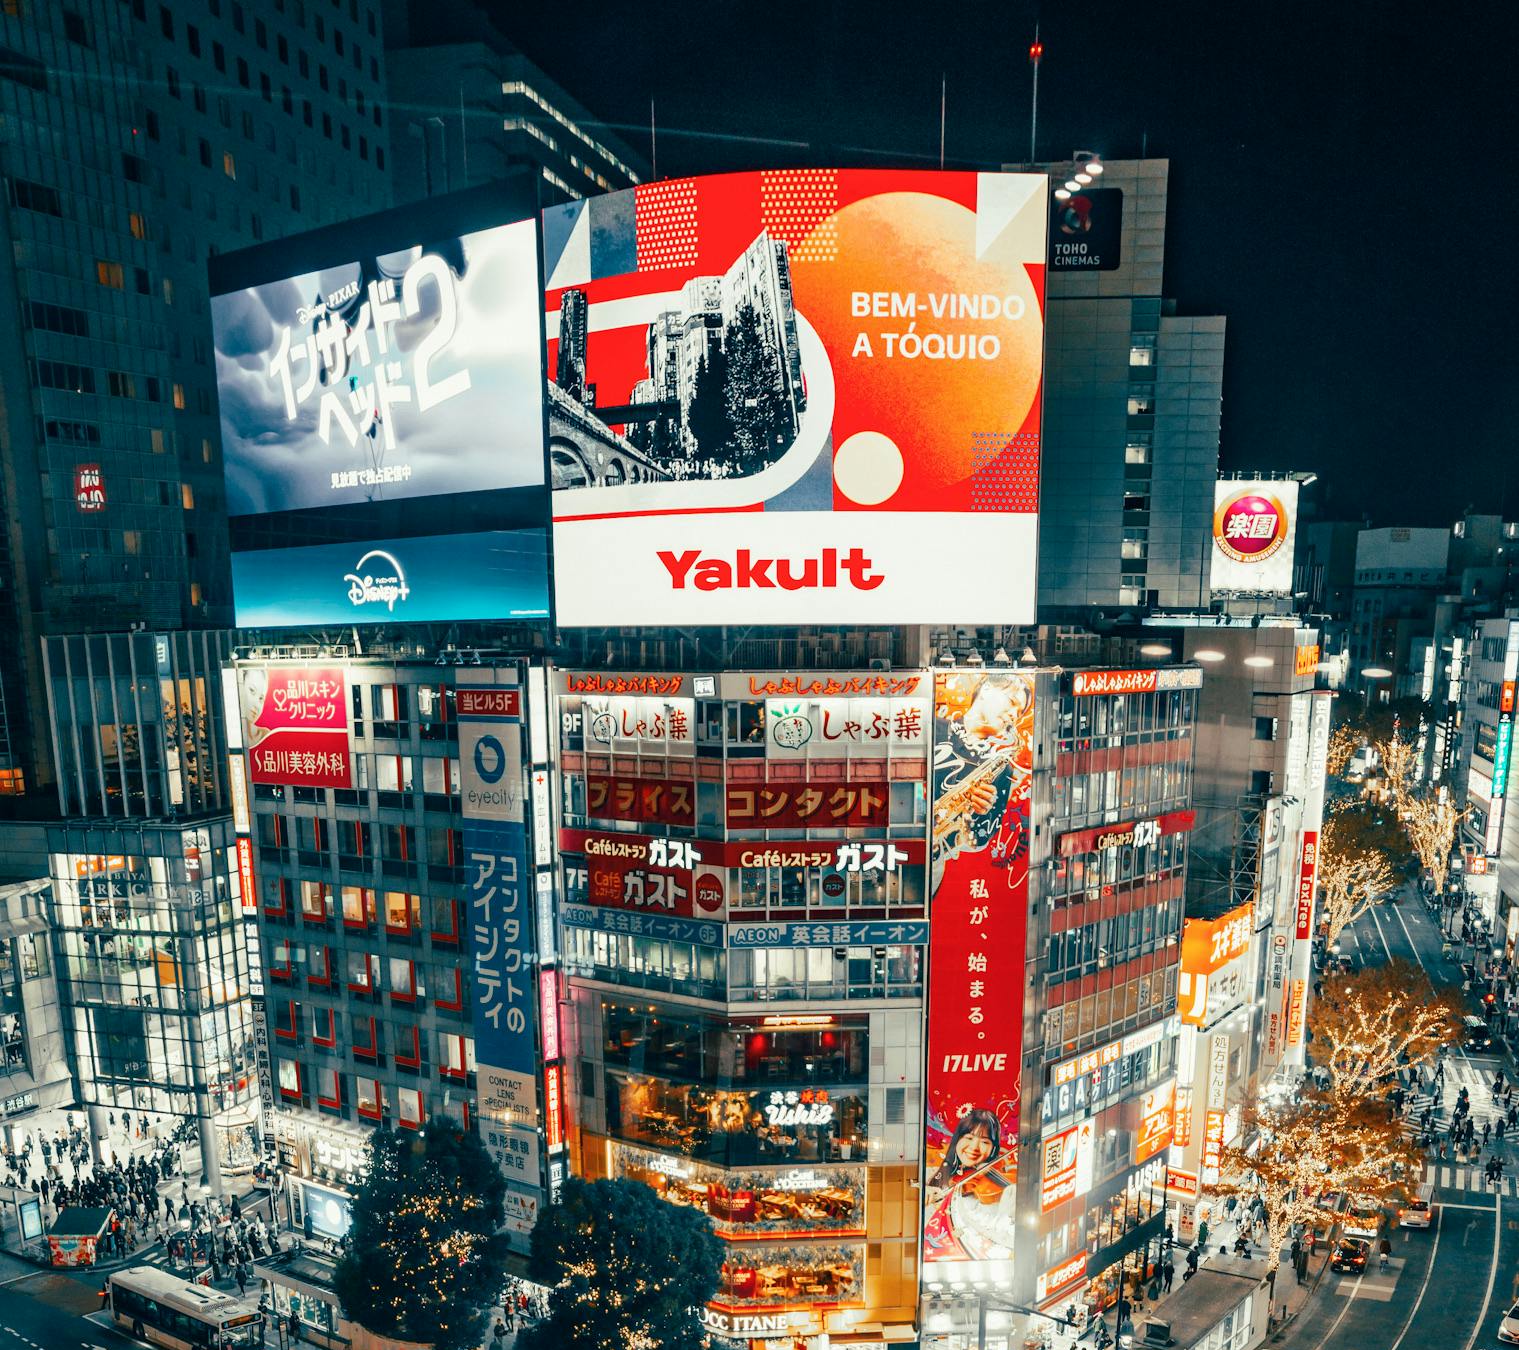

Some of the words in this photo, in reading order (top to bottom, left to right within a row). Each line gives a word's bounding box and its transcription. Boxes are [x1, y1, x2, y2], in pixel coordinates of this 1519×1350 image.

[1054, 255, 1101, 266] CINEMAS
[1055, 243, 1088, 255] TOHO
[329, 281, 361, 308] PIXAR
[851, 291, 1026, 321] BEM-VINDO
[270, 279, 401, 421] インサイド
[402, 254, 473, 413] 2
[852, 332, 873, 358] A
[881, 322, 1001, 360] TÓQUIO
[318, 361, 412, 451] ヘッド
[1224, 512, 1278, 539] 楽園
[1216, 535, 1242, 561] EXCITING
[1243, 536, 1284, 562] AMUSEMENT
[655, 548, 886, 591] Yakult
[286, 680, 341, 699] 品川スキン
[566, 674, 683, 695] しゃぶしゃぶバイキング
[749, 676, 921, 696] しゃぶしゃぶバイキング
[288, 702, 336, 720] クリニック
[462, 692, 513, 712] 当ビル5F
[562, 713, 582, 733] 9F
[621, 708, 689, 741] しゃぶ葉
[823, 707, 922, 741] しゃぶ葉
[263, 750, 346, 777] 品川美容外科
[468, 788, 515, 811] eyecity
[588, 780, 692, 815] プライス
[728, 786, 884, 818] コンタクト
[1132, 820, 1162, 848] ガスト
[585, 838, 647, 859] Caféレストラン
[649, 838, 702, 870] ガスト
[741, 850, 832, 868] Caféレストラン
[835, 842, 909, 872] ガスト
[1304, 842, 1315, 865] 免税
[566, 867, 589, 889] 7F
[594, 870, 622, 888] Café
[623, 870, 687, 909] ガスト
[699, 889, 721, 901] ガスト
[1297, 874, 1314, 929] TaxFree
[565, 908, 593, 923] AEON
[603, 910, 695, 938] 英会話イーオン
[701, 927, 716, 941] 6F
[471, 852, 503, 1029] アイシティ
[501, 856, 526, 1034] コンタクトの
[737, 929, 779, 943] AEON
[791, 925, 925, 945] 英会話イーオン
[967, 878, 990, 1040] 私が、始まる。
[253, 1003, 264, 1014] 3F
[256, 1028, 267, 1047] 内科
[943, 1053, 1007, 1073] 17LIVE
[488, 1075, 523, 1091] CONTACT
[496, 1088, 515, 1101] LENS
[484, 1098, 530, 1116] SPECIALISTS
[1042, 1077, 1085, 1120] AGA
[488, 1132, 530, 1156] 隐形眼镜
[495, 1151, 525, 1170] 专卖店
[1046, 1143, 1061, 1174] 薬
[1127, 1156, 1163, 1195] LUSH
